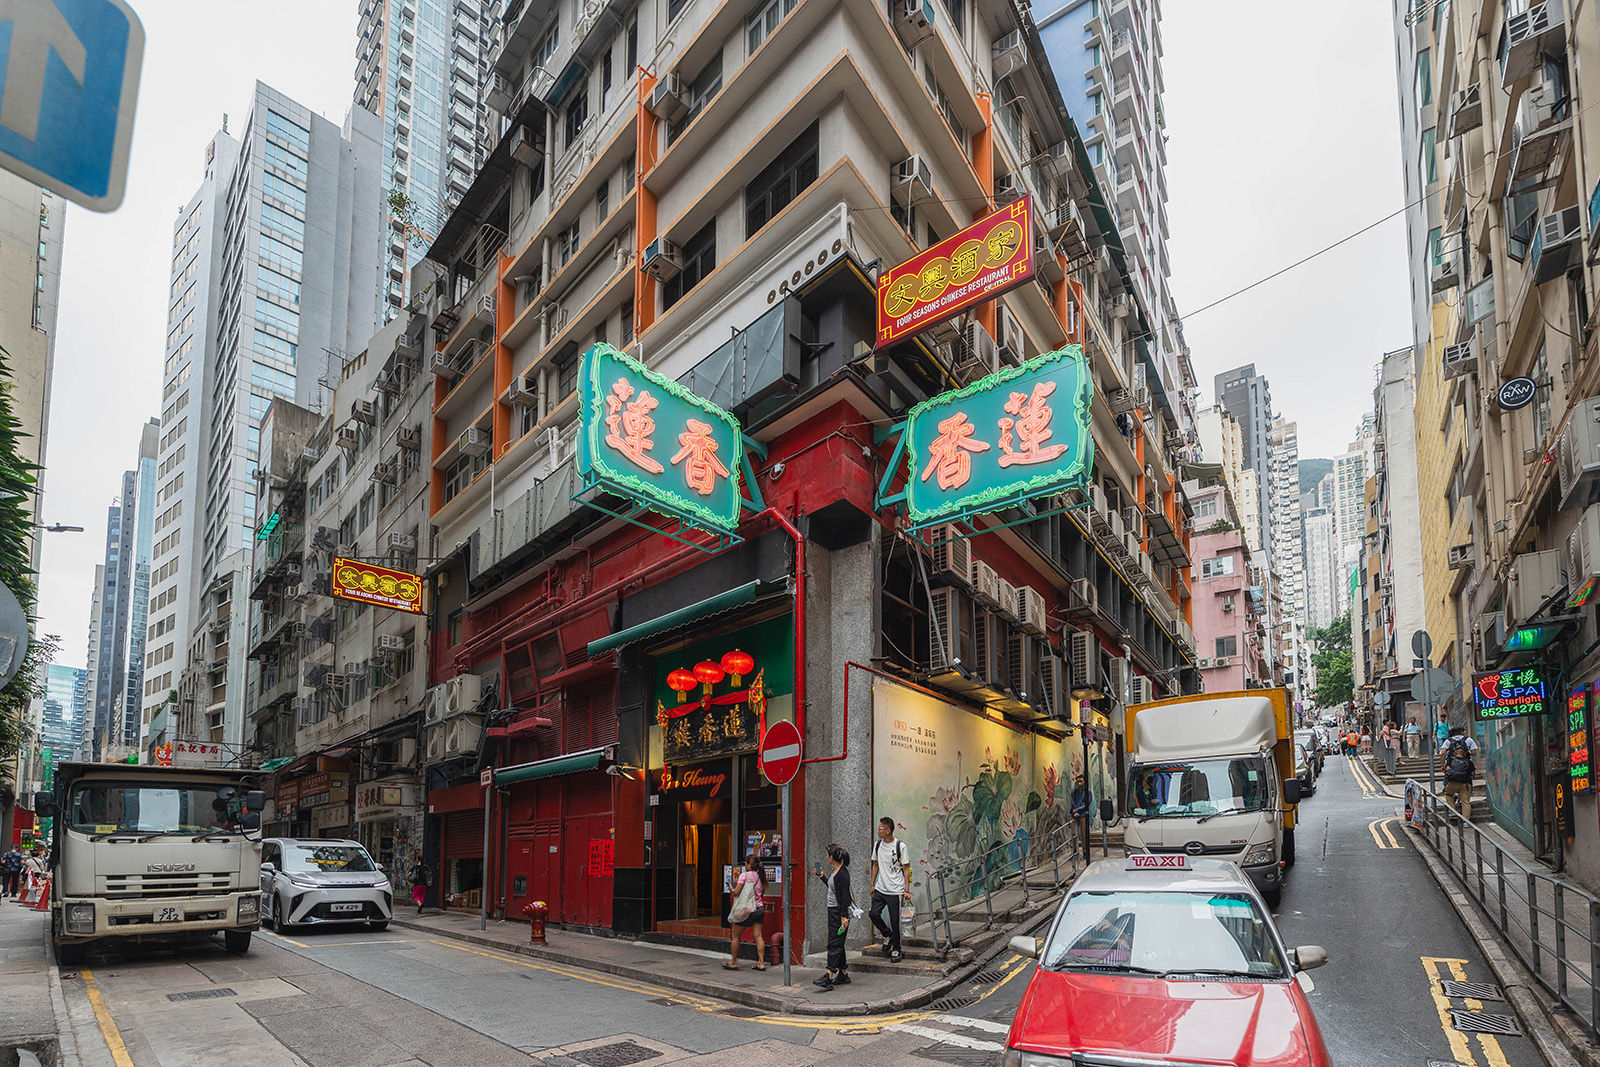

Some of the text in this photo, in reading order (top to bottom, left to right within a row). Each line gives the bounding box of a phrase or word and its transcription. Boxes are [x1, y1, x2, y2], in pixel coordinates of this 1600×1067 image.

[983, 275, 1012, 292] CENTRAL
[896, 265, 1010, 328] FOUR SEASONS CHINESE RESTAURANT
[1503, 384, 1530, 399] RAW
[1501, 686, 1538, 698] SPA
[1480, 695, 1542, 708] 1/F Starlight
[1481, 703, 1542, 717] 6529 1276
[1570, 710, 1585, 731] SPA
[682, 768, 726, 798] Heung
[147, 863, 196, 873] ISUZU
[1132, 856, 1185, 867] TAXI
[158, 913, 179, 922] 742
[162, 907, 176, 915] SP
